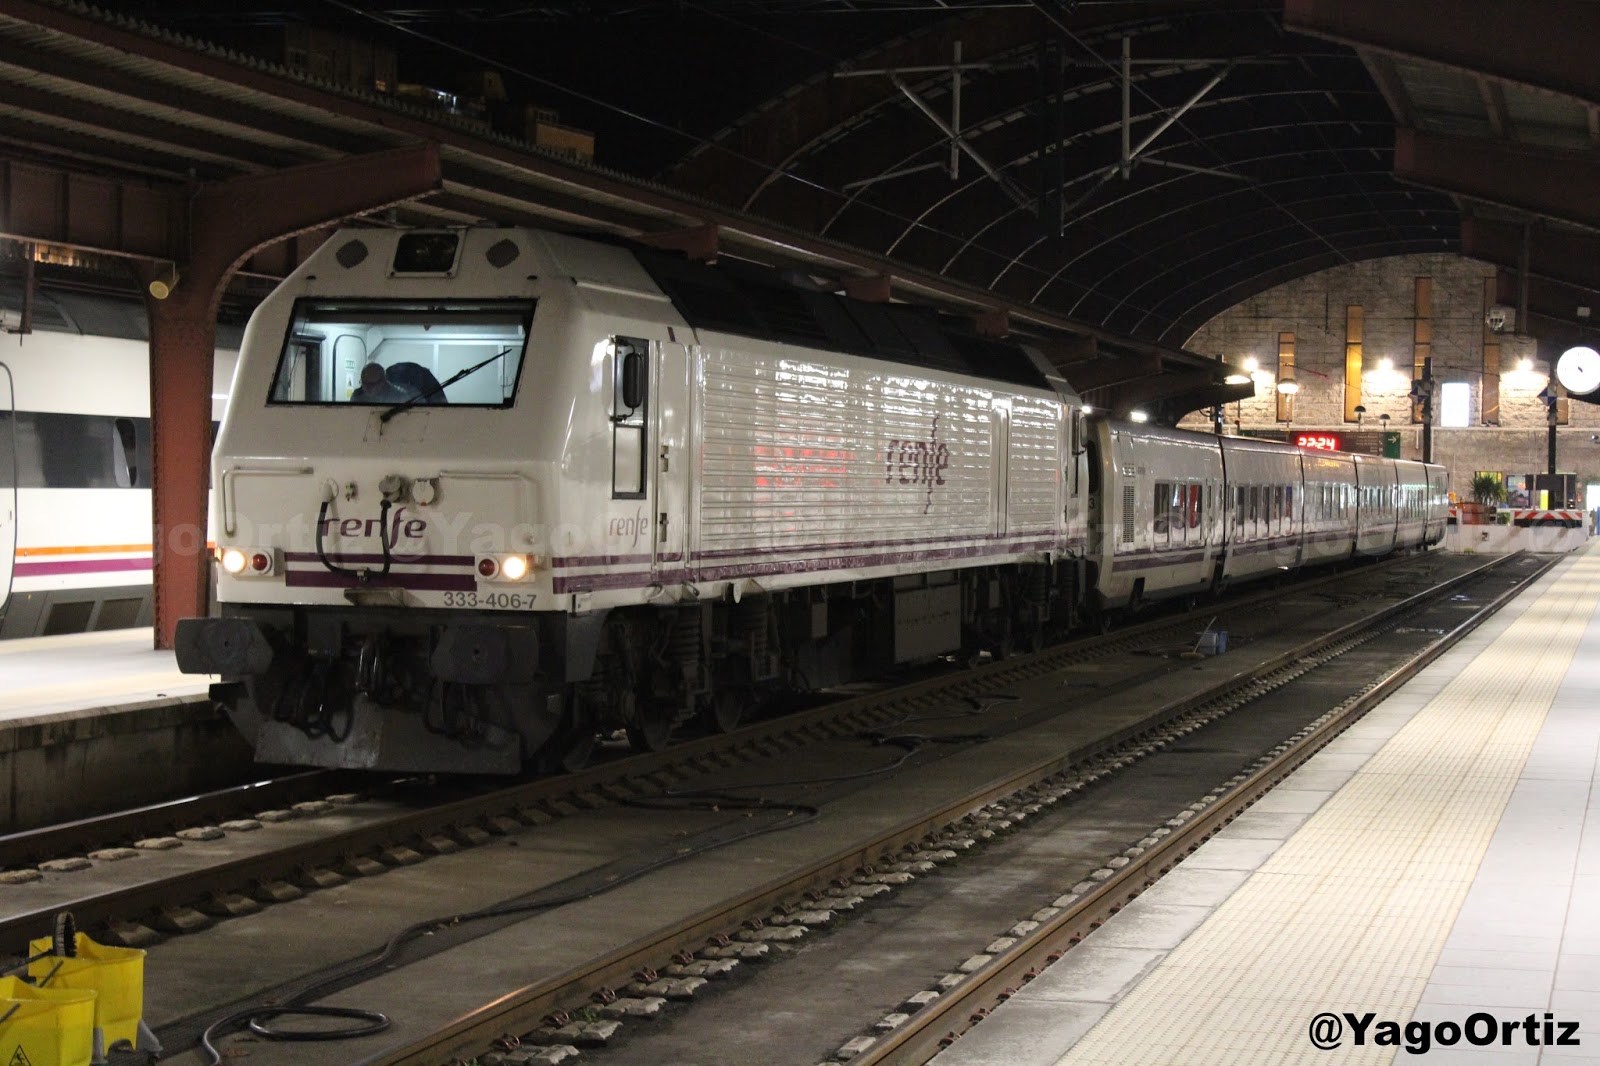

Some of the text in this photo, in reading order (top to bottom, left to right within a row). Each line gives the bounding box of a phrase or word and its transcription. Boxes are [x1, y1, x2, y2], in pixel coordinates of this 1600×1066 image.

[886, 415, 950, 514] renfe
[322, 507, 427, 549] renfe
[609, 505, 649, 548] renfe
[443, 591, 537, 609] 333-406-7
